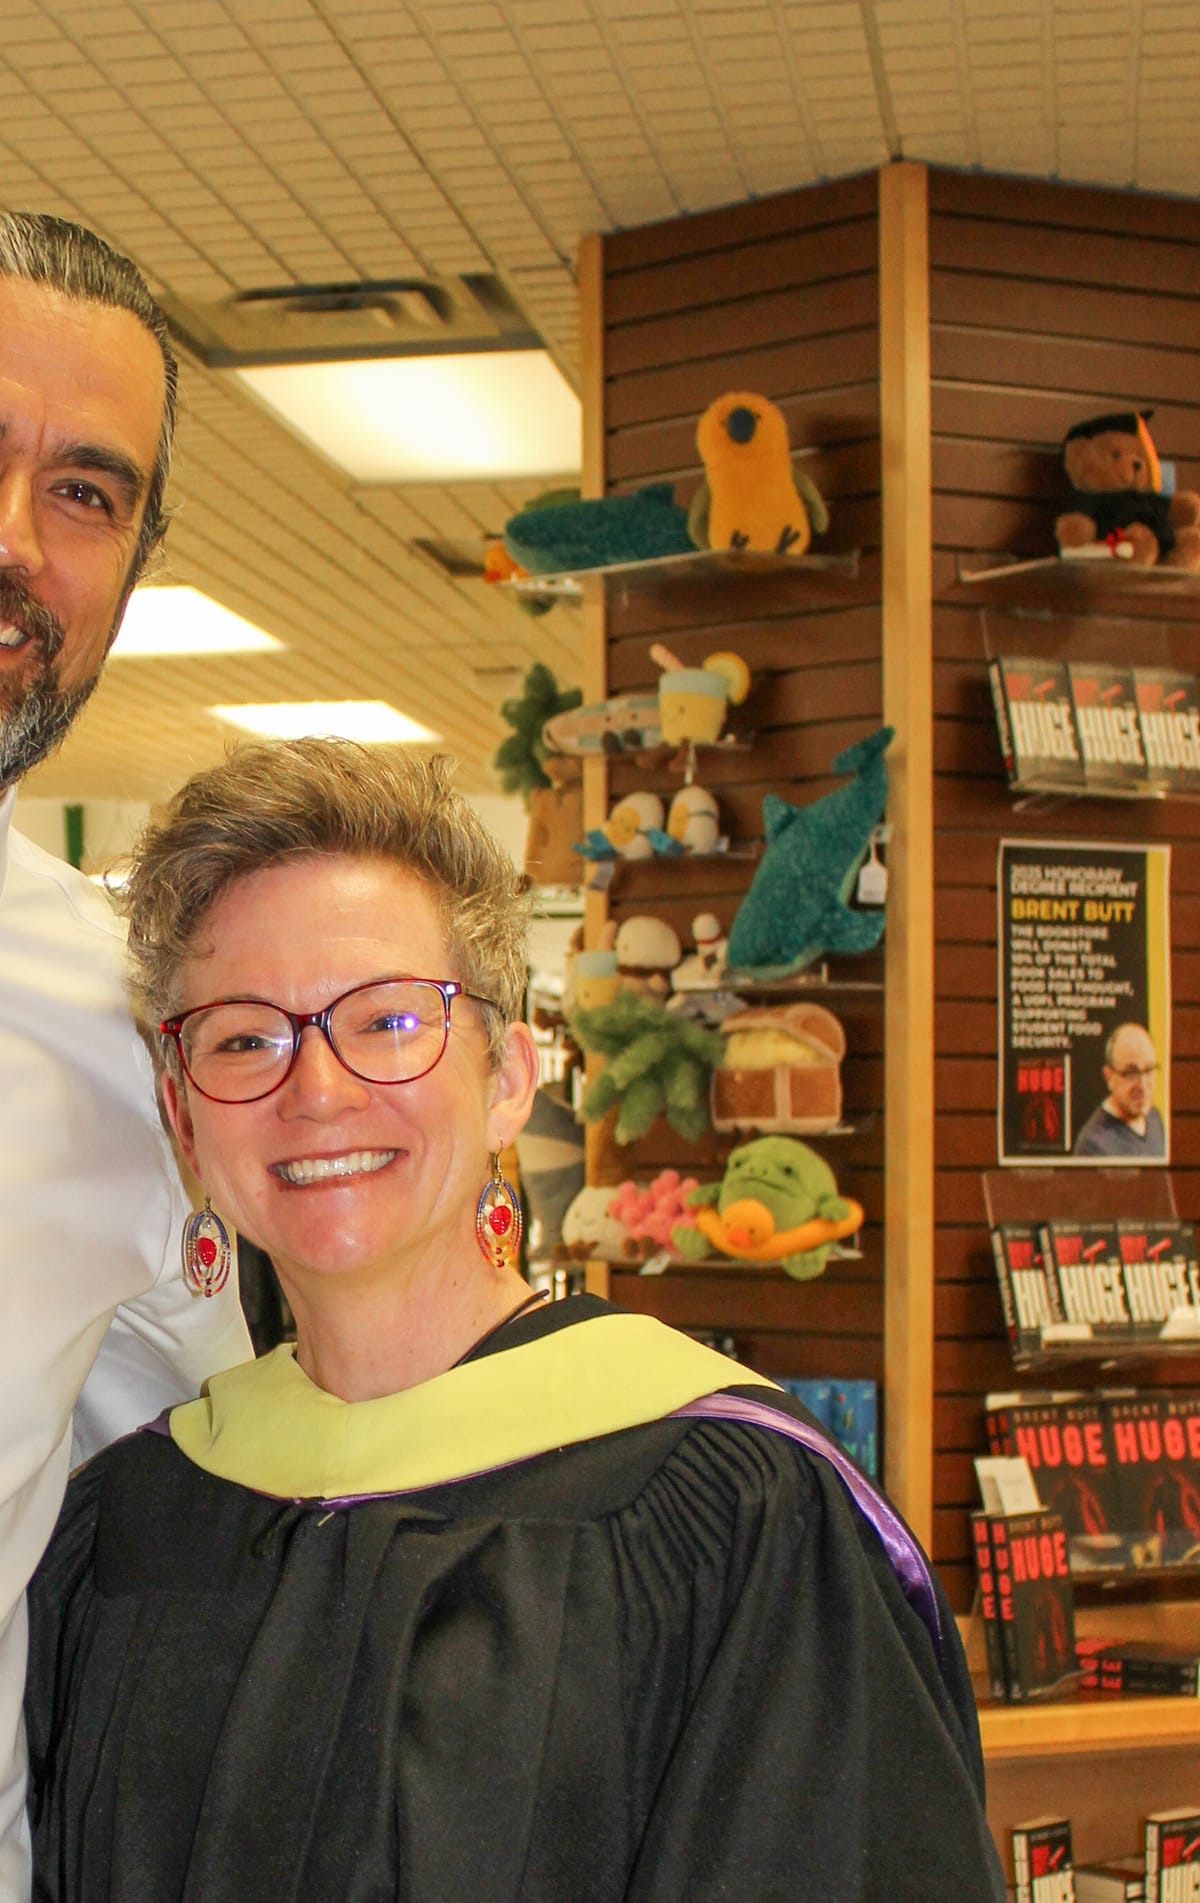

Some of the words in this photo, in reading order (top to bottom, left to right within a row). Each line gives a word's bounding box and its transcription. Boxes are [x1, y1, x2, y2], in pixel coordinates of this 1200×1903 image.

[1009, 701, 1080, 760] HUGE
[1075, 706, 1145, 765] HUGE
[1011, 898, 1080, 921] BRENT
[1084, 900, 1136, 924] BUTT
[1017, 1067, 1064, 1094] HUGE
[1057, 1264, 1130, 1324] HUGE
[1015, 1422, 1108, 1470] HUGE
[1113, 1416, 1200, 1465] HUGE
[1011, 1531, 1069, 1583] HUGE
